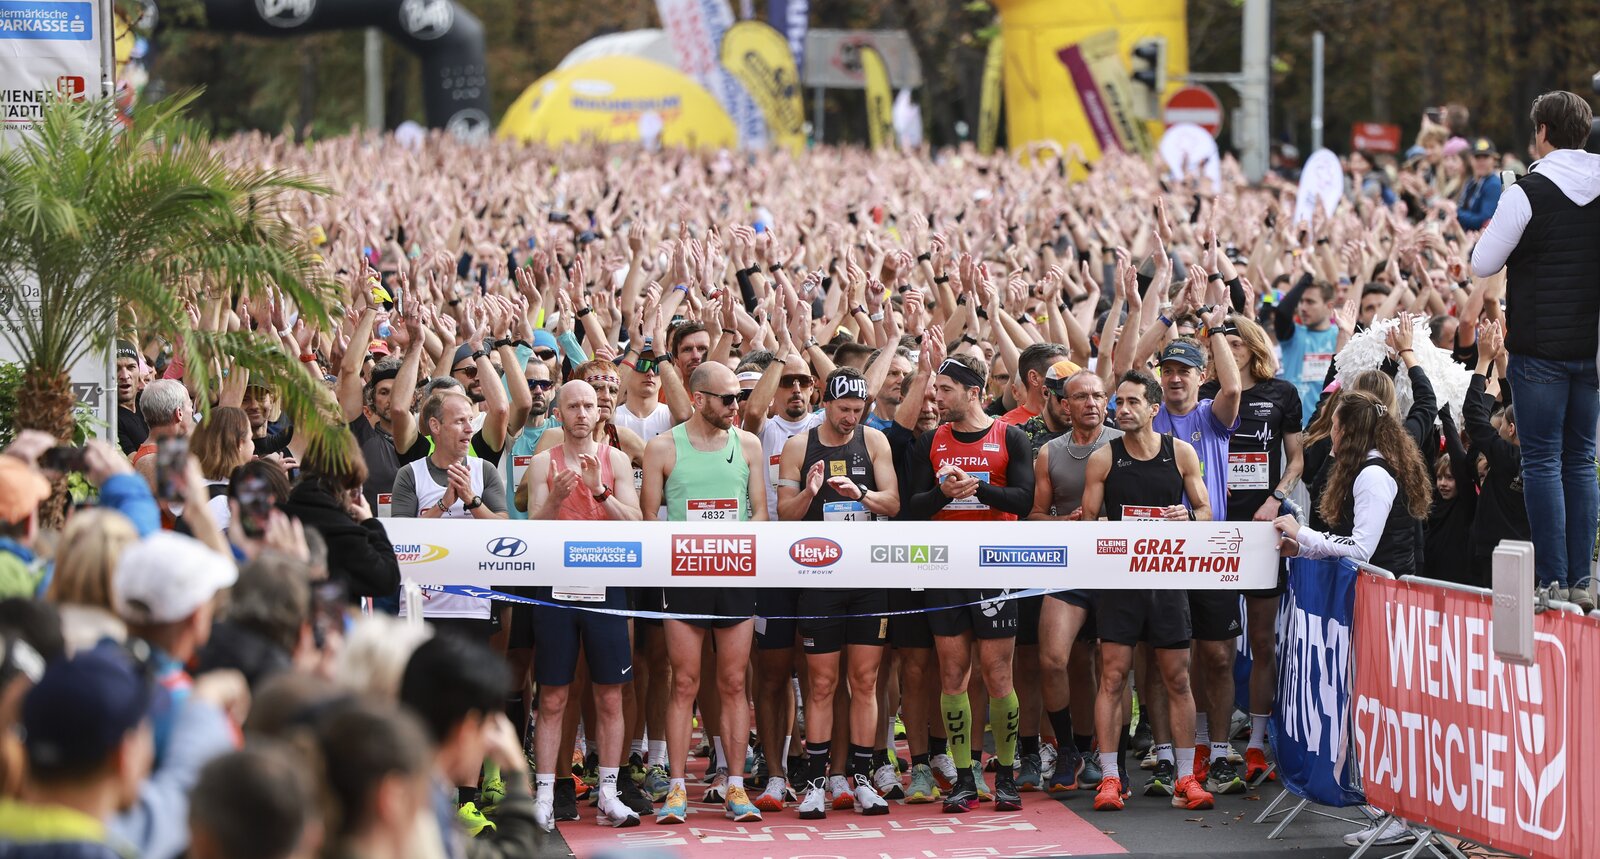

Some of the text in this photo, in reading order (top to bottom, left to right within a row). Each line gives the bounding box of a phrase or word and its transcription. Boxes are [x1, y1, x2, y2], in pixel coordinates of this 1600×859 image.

[939, 456, 989, 468] AUSTRIA
[1232, 464, 1256, 473] 4436
[701, 510, 725, 520] 4832
[844, 513, 856, 521] 41
[393, 544, 421, 553] SIUM
[569, 546, 626, 555] Steiermärkische
[676, 539, 752, 554] KLEINE
[795, 545, 839, 560] Hervis
[1134, 539, 1186, 555] GRAZ
[569, 554, 625, 563] SPARKASSE
[873, 547, 945, 562] GRAZ
[986, 549, 1061, 563] PUNTIGAMER
[479, 562, 536, 571] HYUNDAI
[676, 556, 752, 572] ZEITUNG
[1129, 556, 1240, 573] MARATHON
[1220, 574, 1239, 582] 2024
[992, 619, 1017, 628] NIKE
[1385, 601, 1509, 713] WIENER
[1355, 694, 1508, 825] STÄDTISCHE
